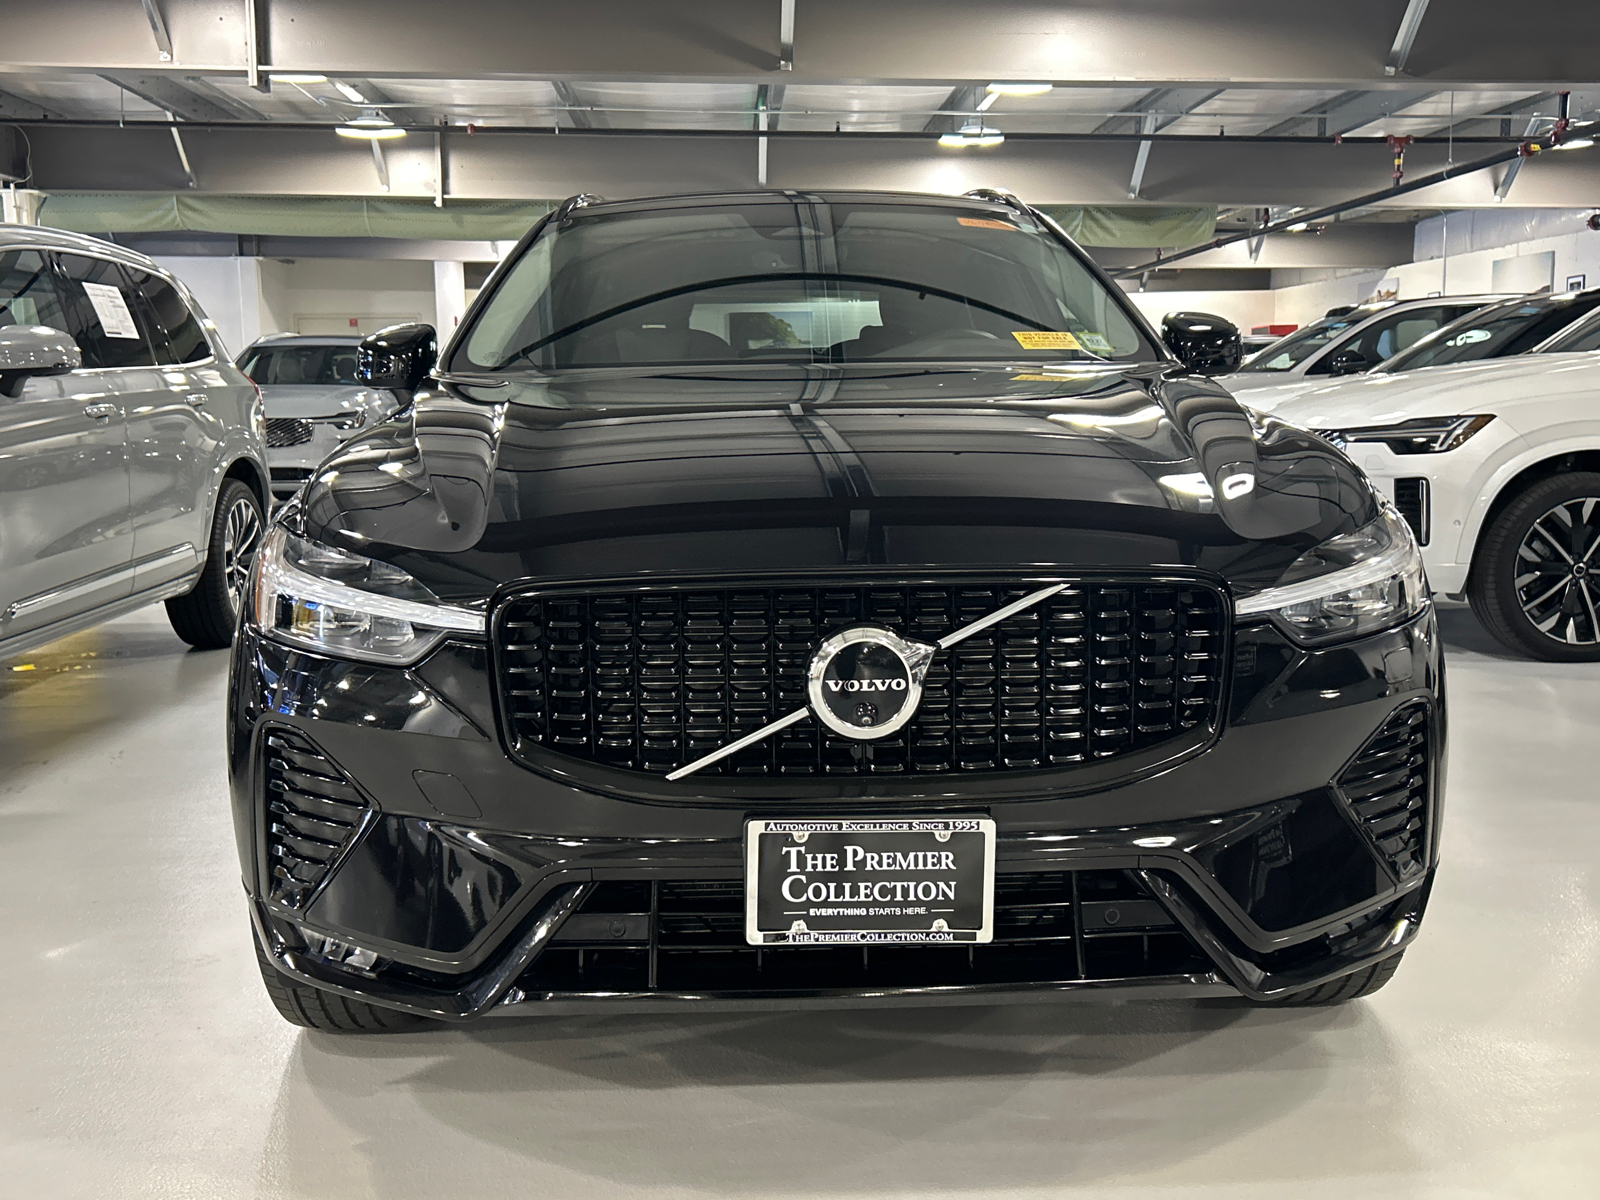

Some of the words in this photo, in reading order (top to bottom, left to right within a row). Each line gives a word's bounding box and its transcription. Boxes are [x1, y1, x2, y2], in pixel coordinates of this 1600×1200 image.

[825, 678, 907, 692] VOLVO
[766, 822, 838, 831] AUTOMOTIVE
[842, 822, 909, 831] EXCELLENCE
[912, 821, 944, 831] SINCE
[948, 821, 978, 831] 1995
[782, 845, 839, 872] THE
[843, 845, 957, 871] PREMIER
[781, 874, 957, 903] COLLECTION
[809, 908, 867, 916] EVERYTHING
[868, 907, 901, 915] STARTS
[902, 907, 928, 915] HERE.
[786, 932, 954, 943] THEPREMIERCOLLECTION.COM
